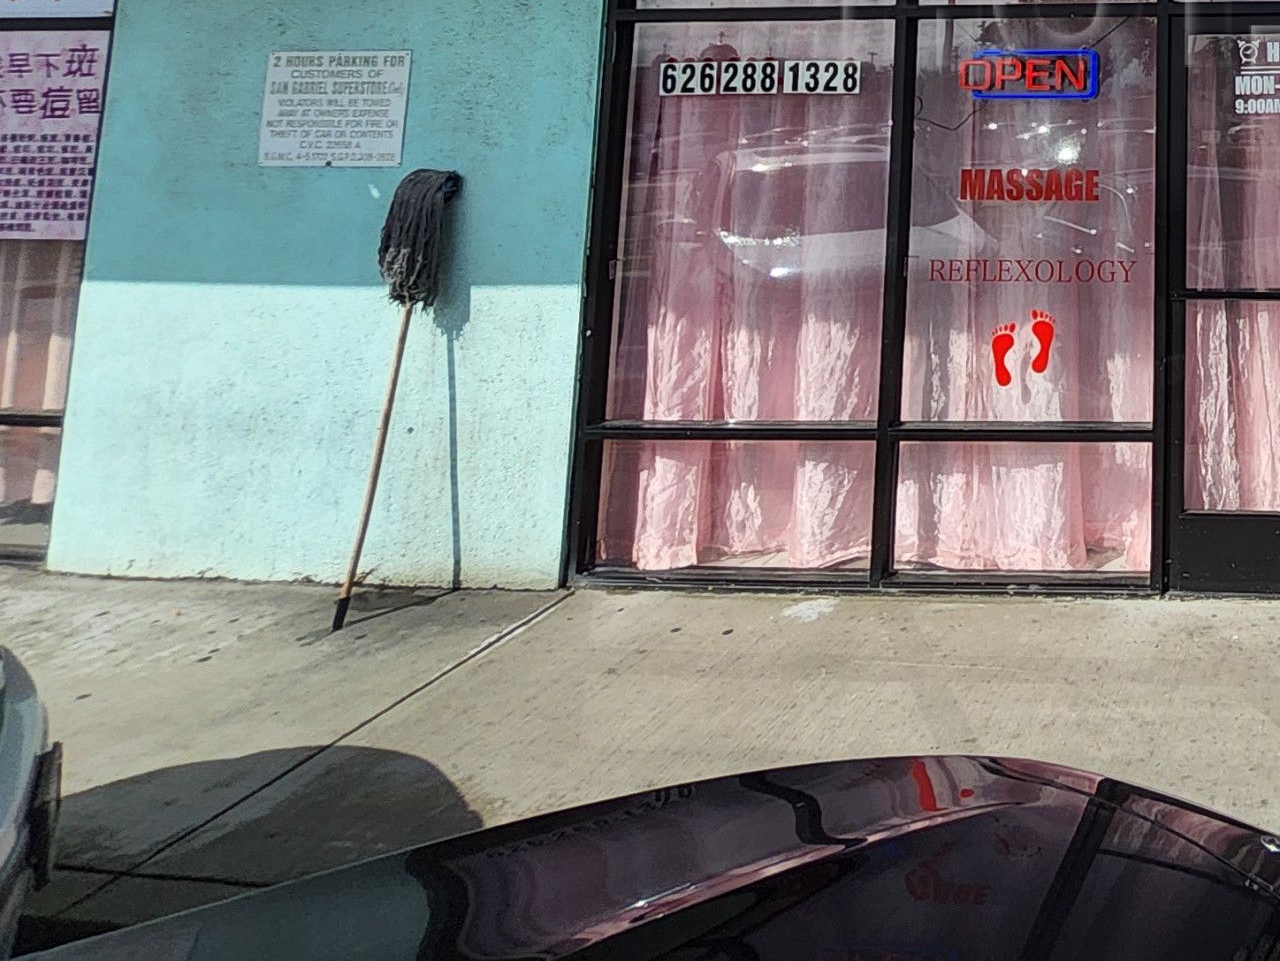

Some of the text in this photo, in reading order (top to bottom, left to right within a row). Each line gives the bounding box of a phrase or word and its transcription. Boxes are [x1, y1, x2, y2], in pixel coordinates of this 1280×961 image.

[0, 44, 99, 77] 早下斑
[273, 56, 405, 67] 2 HOURS PARKING FOR
[291, 70, 384, 79] CUSTOMERS OF
[662, 62, 858, 94] 626 288 1328
[959, 58, 1086, 91] OPEN
[278, 99, 391, 107] VIOLATORS WILL BE TOWED
[352, 109, 390, 118] EXPENSE
[266, 120, 283, 128] NOT
[345, 120, 362, 128] FOR
[365, 120, 383, 128] FIRE
[385, 120, 399, 128] OR
[301, 130, 313, 139] OF
[334, 130, 347, 139] OR
[349, 130, 394, 139] CONTENTS
[959, 169, 1099, 201] MASSAGE
[929, 259, 1137, 283] REFLEXOLOGY
